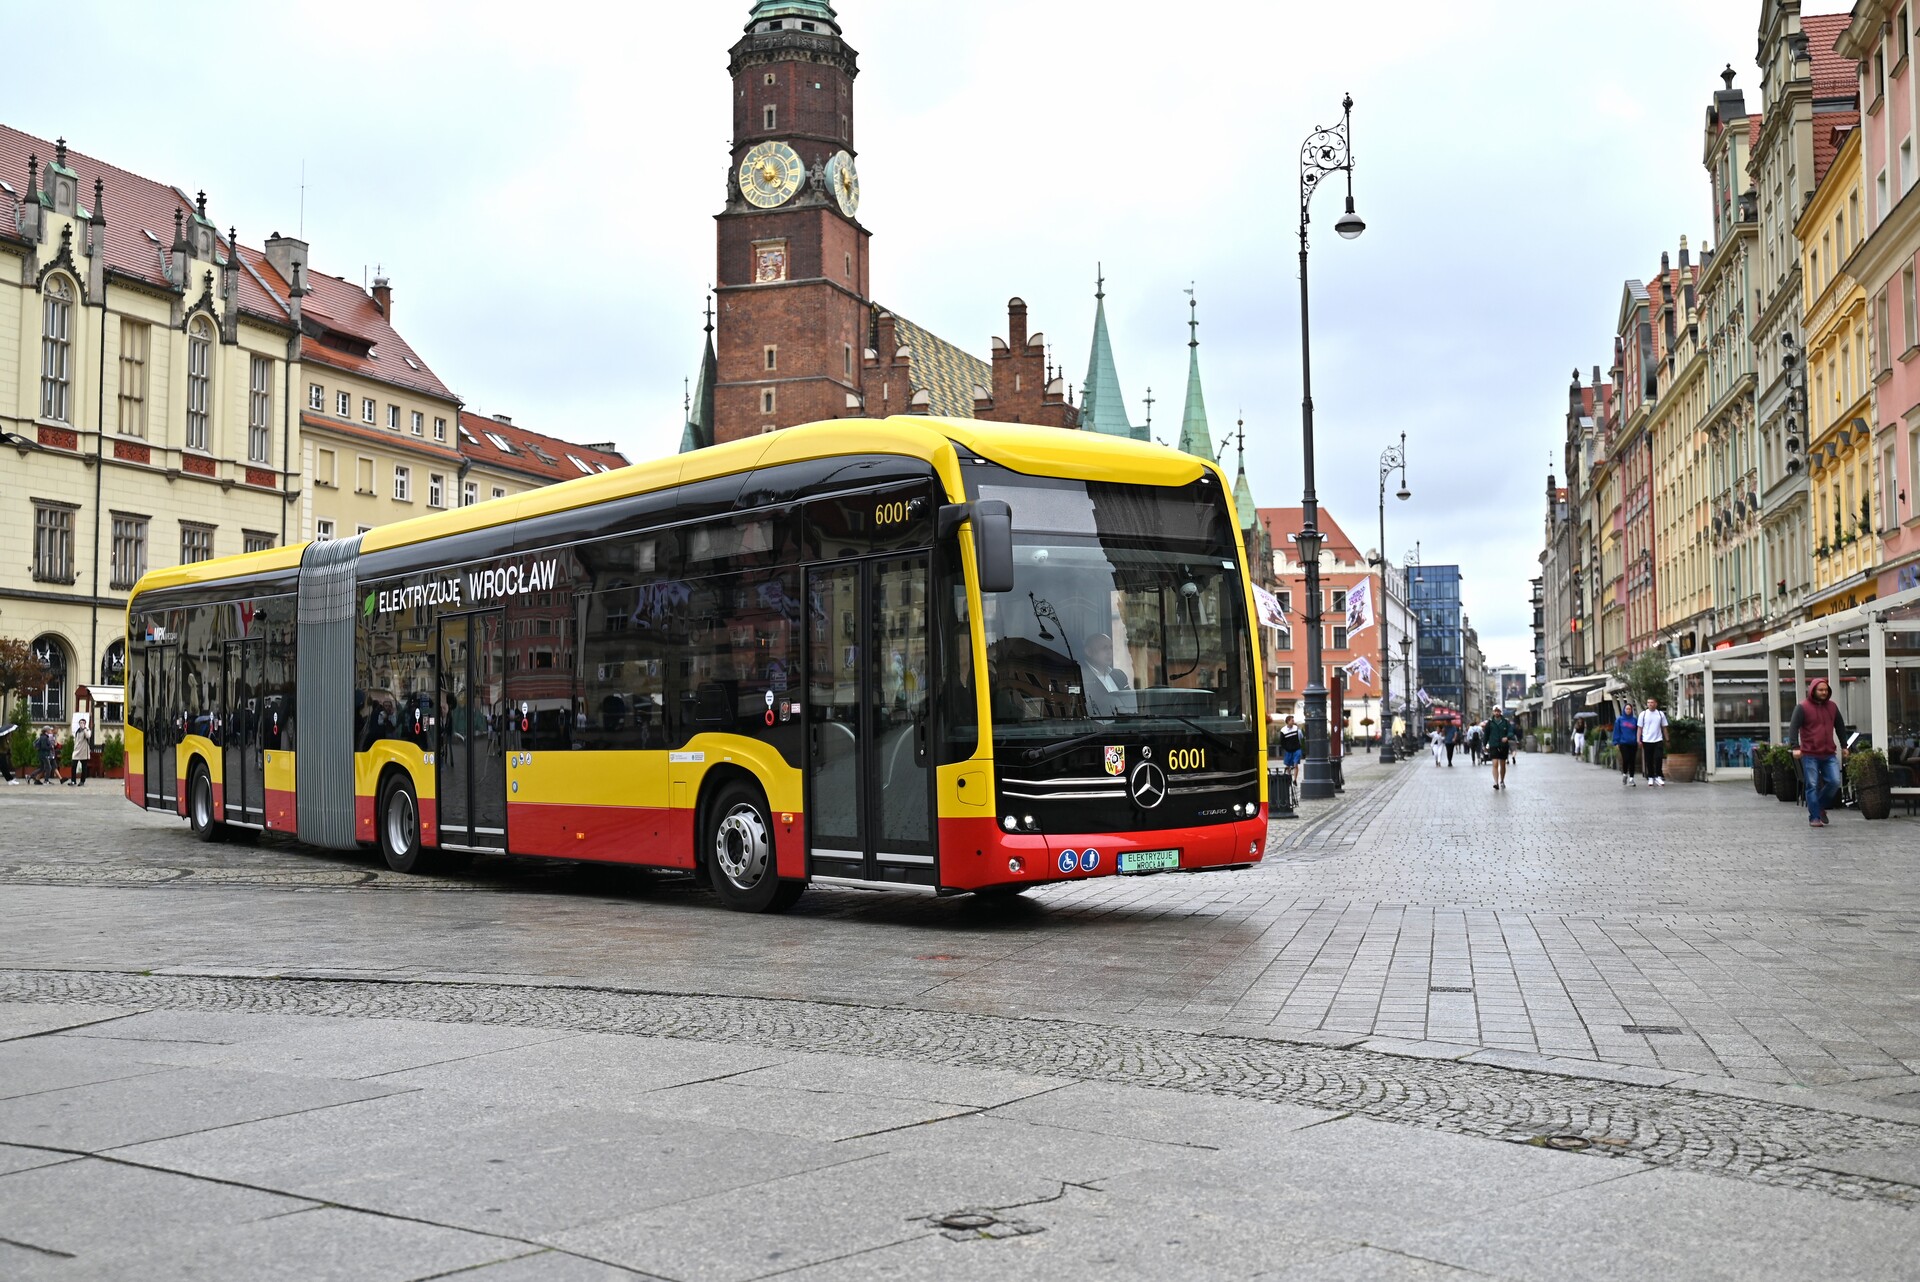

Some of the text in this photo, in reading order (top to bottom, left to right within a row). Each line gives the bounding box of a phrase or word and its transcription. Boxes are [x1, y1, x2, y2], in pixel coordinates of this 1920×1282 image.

[875, 500, 909, 525] 6001
[379, 559, 557, 613] ELEKTRYZUJĘ WROCŁAW
[153, 627, 166, 641] MPK
[1168, 748, 1205, 770] 6001
[1128, 851, 1173, 863] ELEKTRYZUJE
